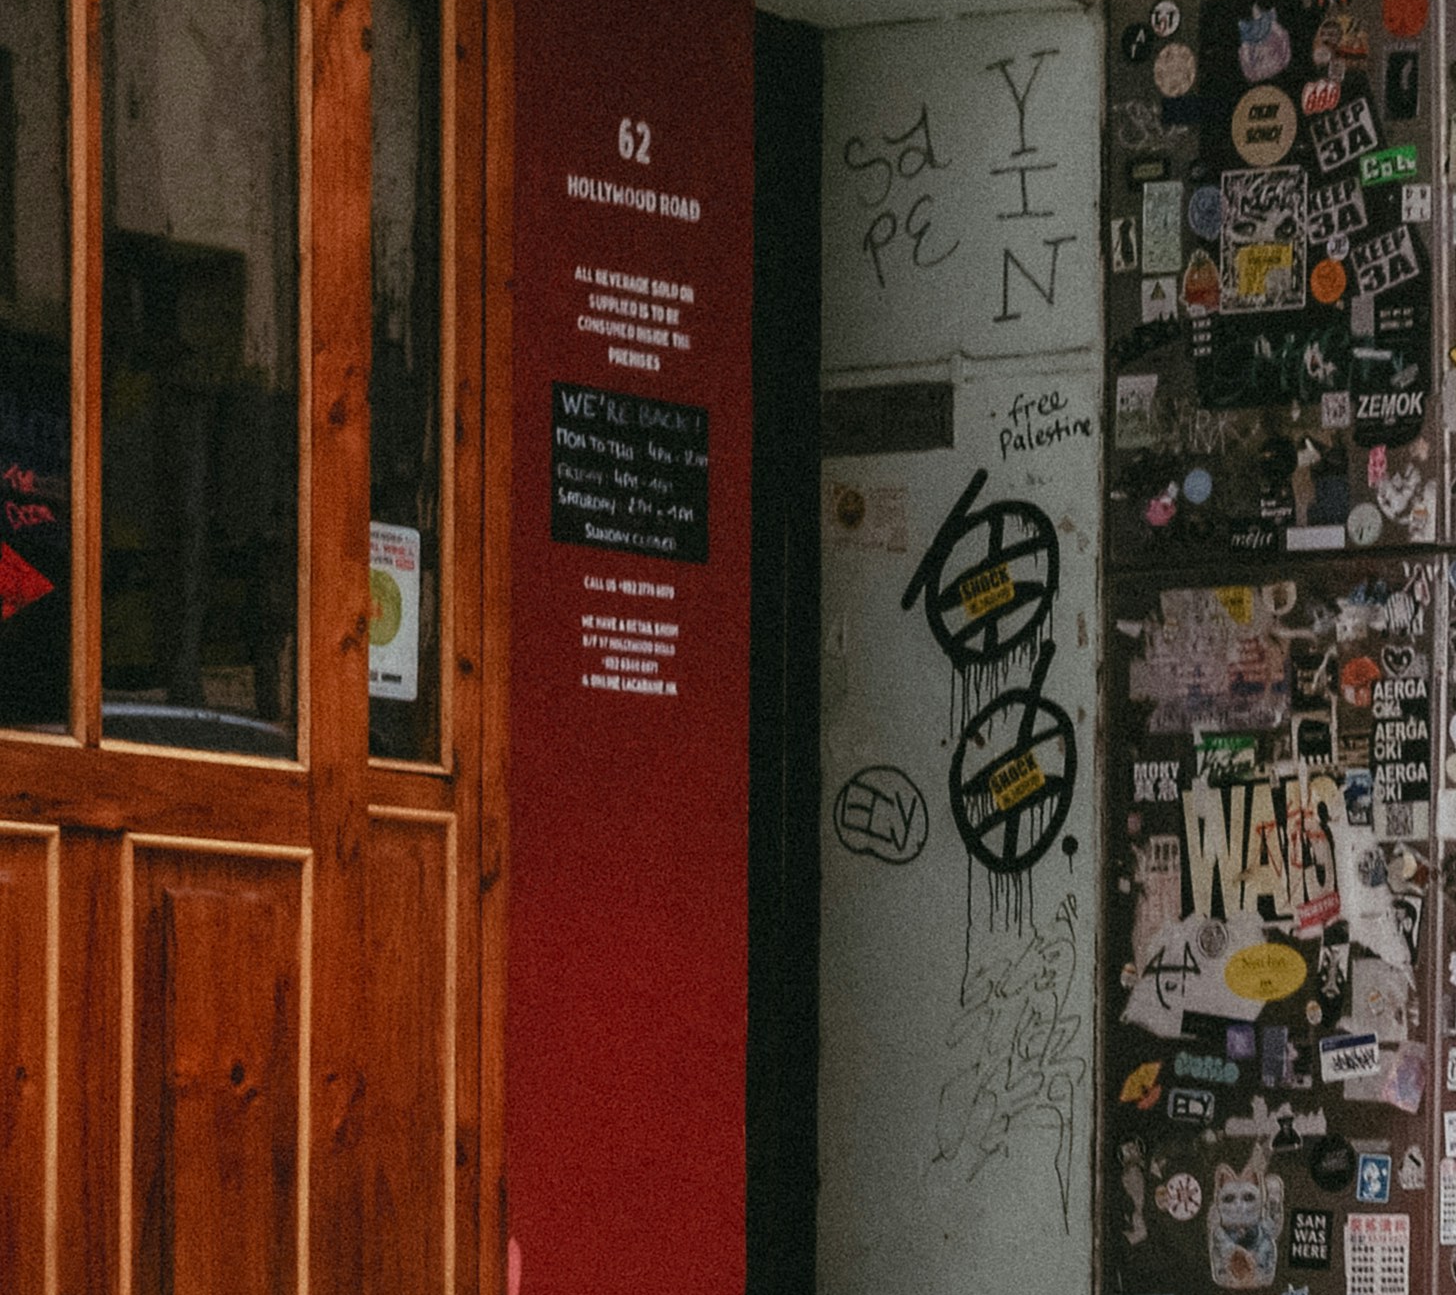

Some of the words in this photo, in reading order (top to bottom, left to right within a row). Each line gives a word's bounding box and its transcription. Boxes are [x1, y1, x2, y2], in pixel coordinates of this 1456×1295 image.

[618, 118, 652, 165] 62
[567, 174, 656, 213] HOLLYWOOD
[659, 193, 701, 223] ROAD
[575, 266, 592, 283] ALL
[595, 269, 649, 295] BEVERAGE
[651, 279, 679, 301] SOLD
[589, 293, 637, 318] SUPPLIED
[651, 304, 664, 322] TO
[578, 315, 636, 341] CONSUMED
[608, 346, 661, 371] PREMISES
[560, 390, 627, 426] WE'RE
[1357, 391, 1424, 419] ZEMOK
[960, 567, 1011, 601] SHOCK
[1373, 678, 1427, 700] AERGA
[1374, 719, 1428, 741] AERGA
[991, 753, 1038, 793] SHOCK
[1374, 761, 1428, 783] AERGA
[1295, 1213, 1327, 1230] SAM
[1292, 1229, 1327, 1245] WAS
[1292, 1243, 1328, 1261] HERE
